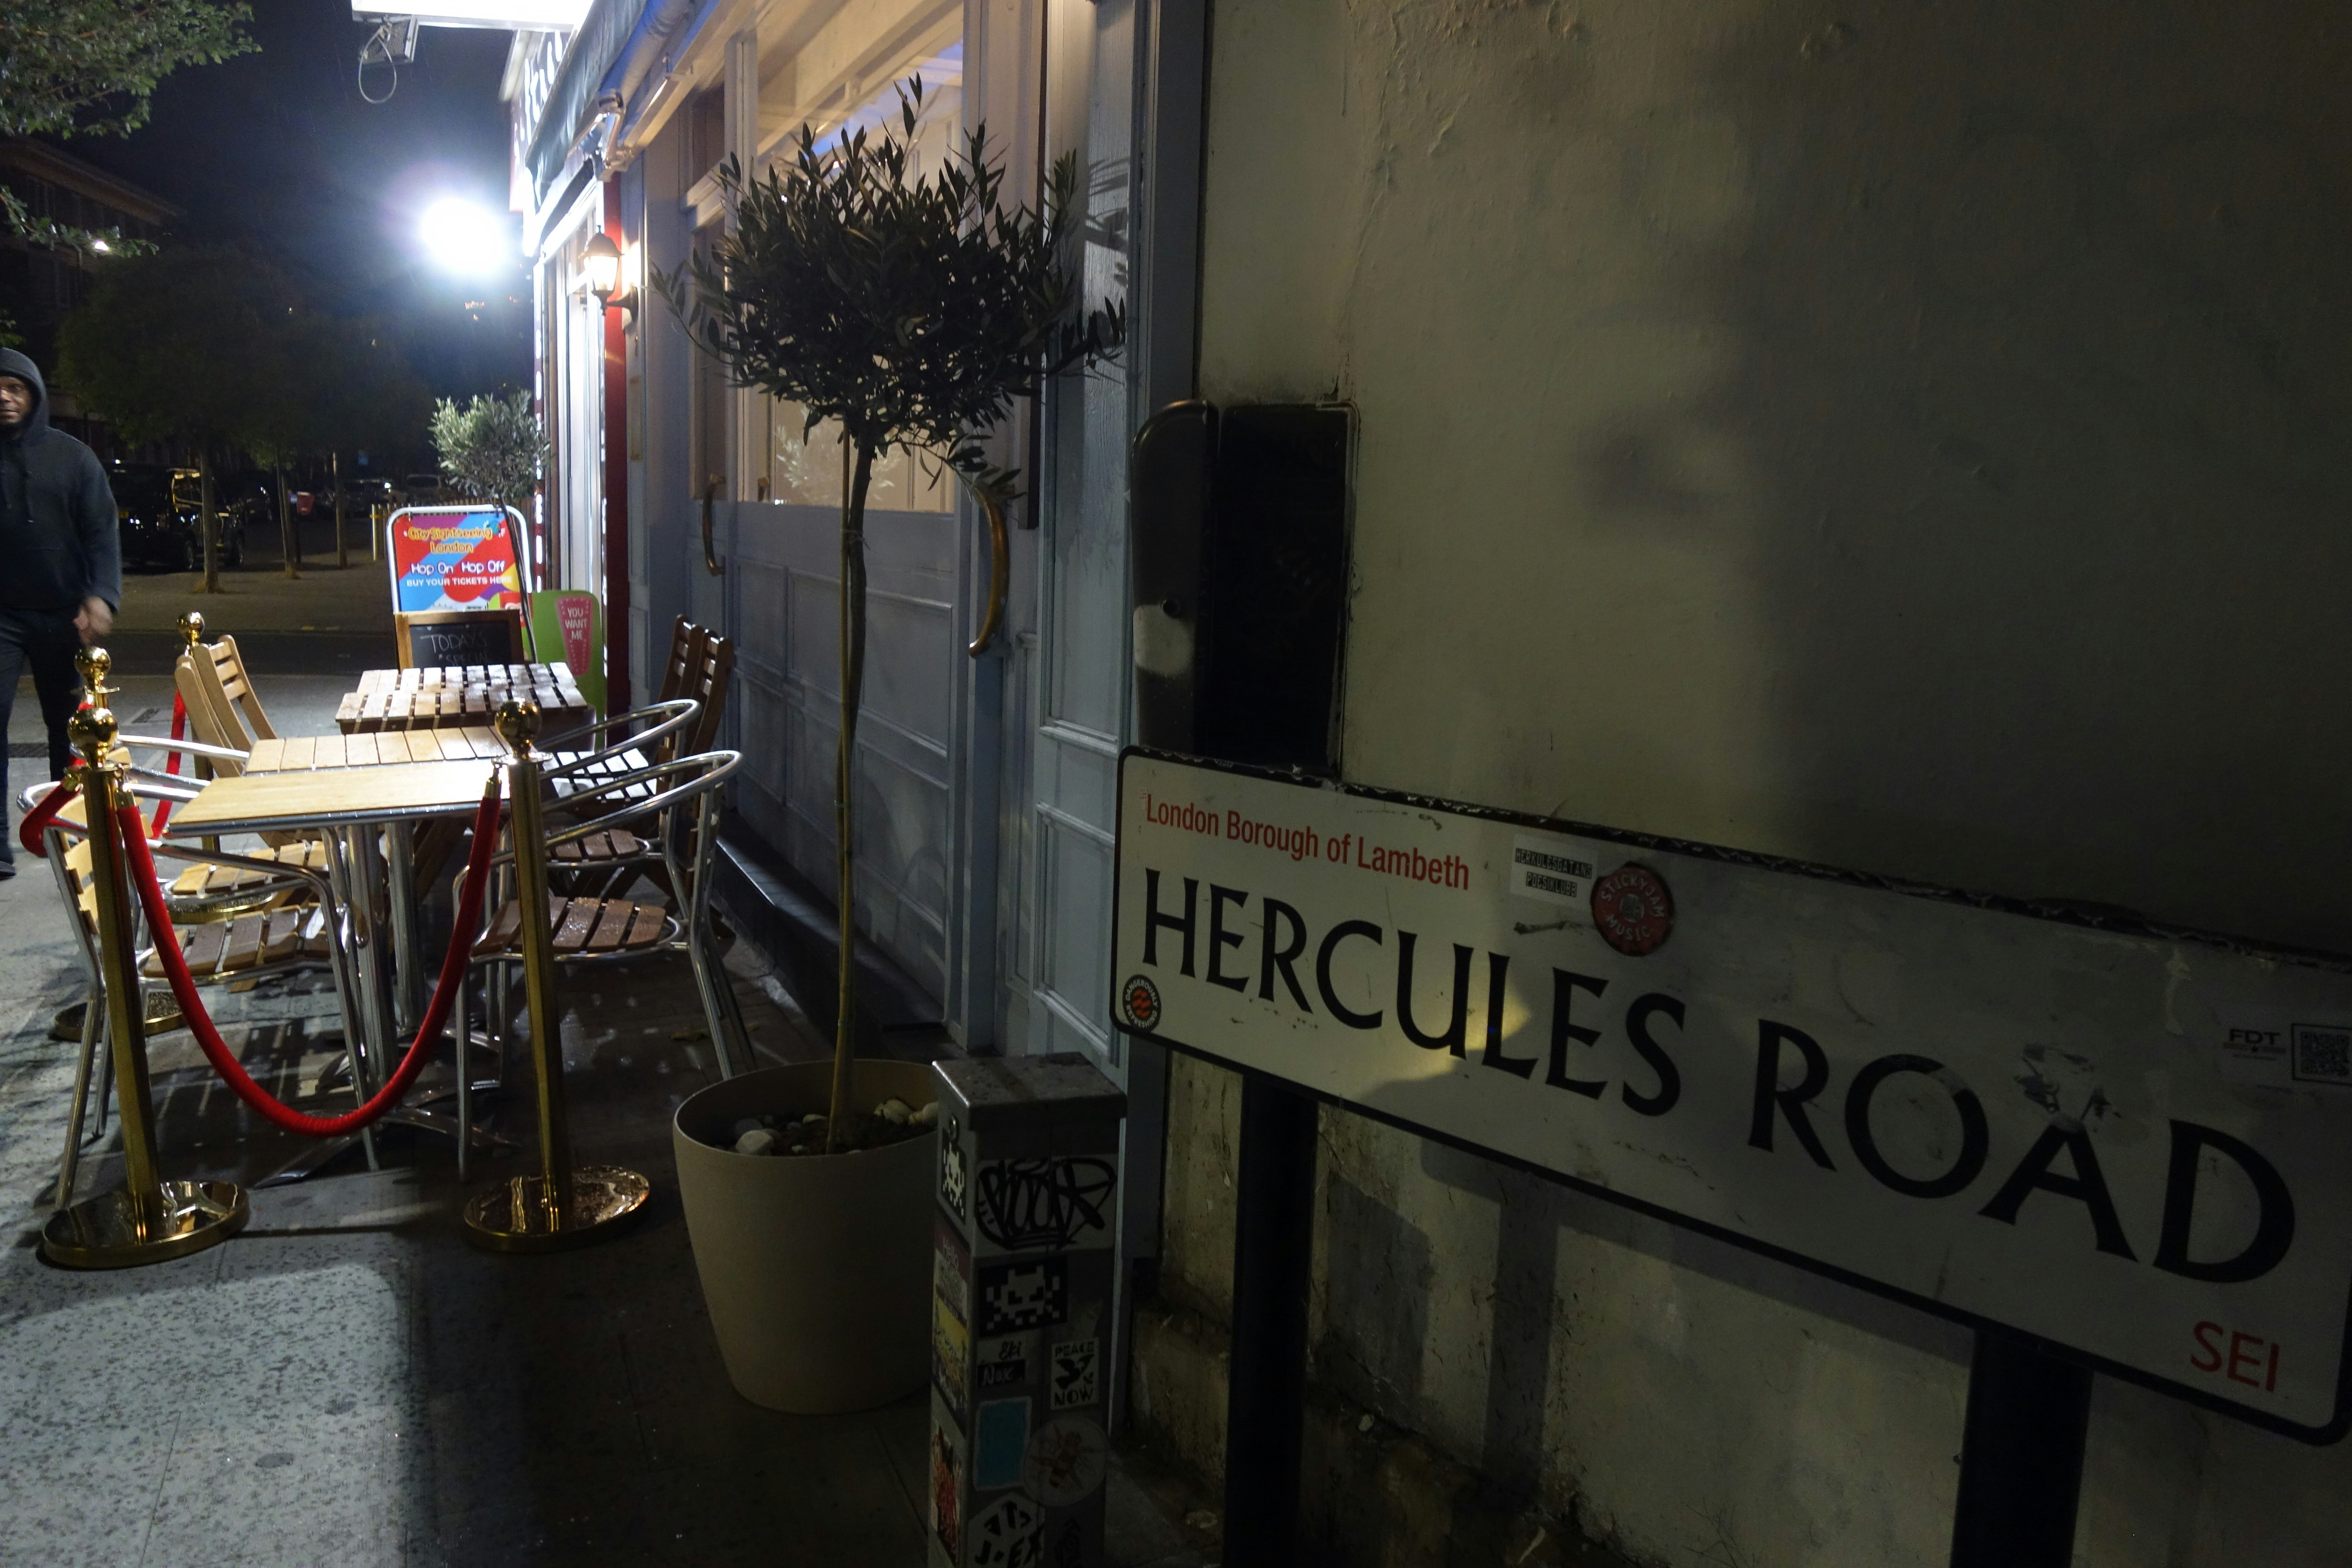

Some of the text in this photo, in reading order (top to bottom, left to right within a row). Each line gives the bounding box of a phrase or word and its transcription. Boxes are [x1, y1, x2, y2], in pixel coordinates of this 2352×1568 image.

[430, 541, 474, 554] London
[411, 560, 505, 576] Hop On Hop Off
[452, 577, 487, 585] TICKETS
[489, 576, 512, 584] HERE
[567, 607, 583, 618] YOU
[565, 619, 588, 629] WANT
[571, 630, 583, 640] ME
[1146, 794, 1470, 890] London Borough of Lambeth
[1606, 913, 1651, 941] MUSIC
[1125, 978, 1158, 1007] DANGEROUSLY
[2229, 1029, 2280, 1045] FDT
[1142, 867, 2296, 1283] HERCULES ROAD
[1054, 1341, 1095, 1357] PEACE
[1054, 1387, 1094, 1406] NOW
